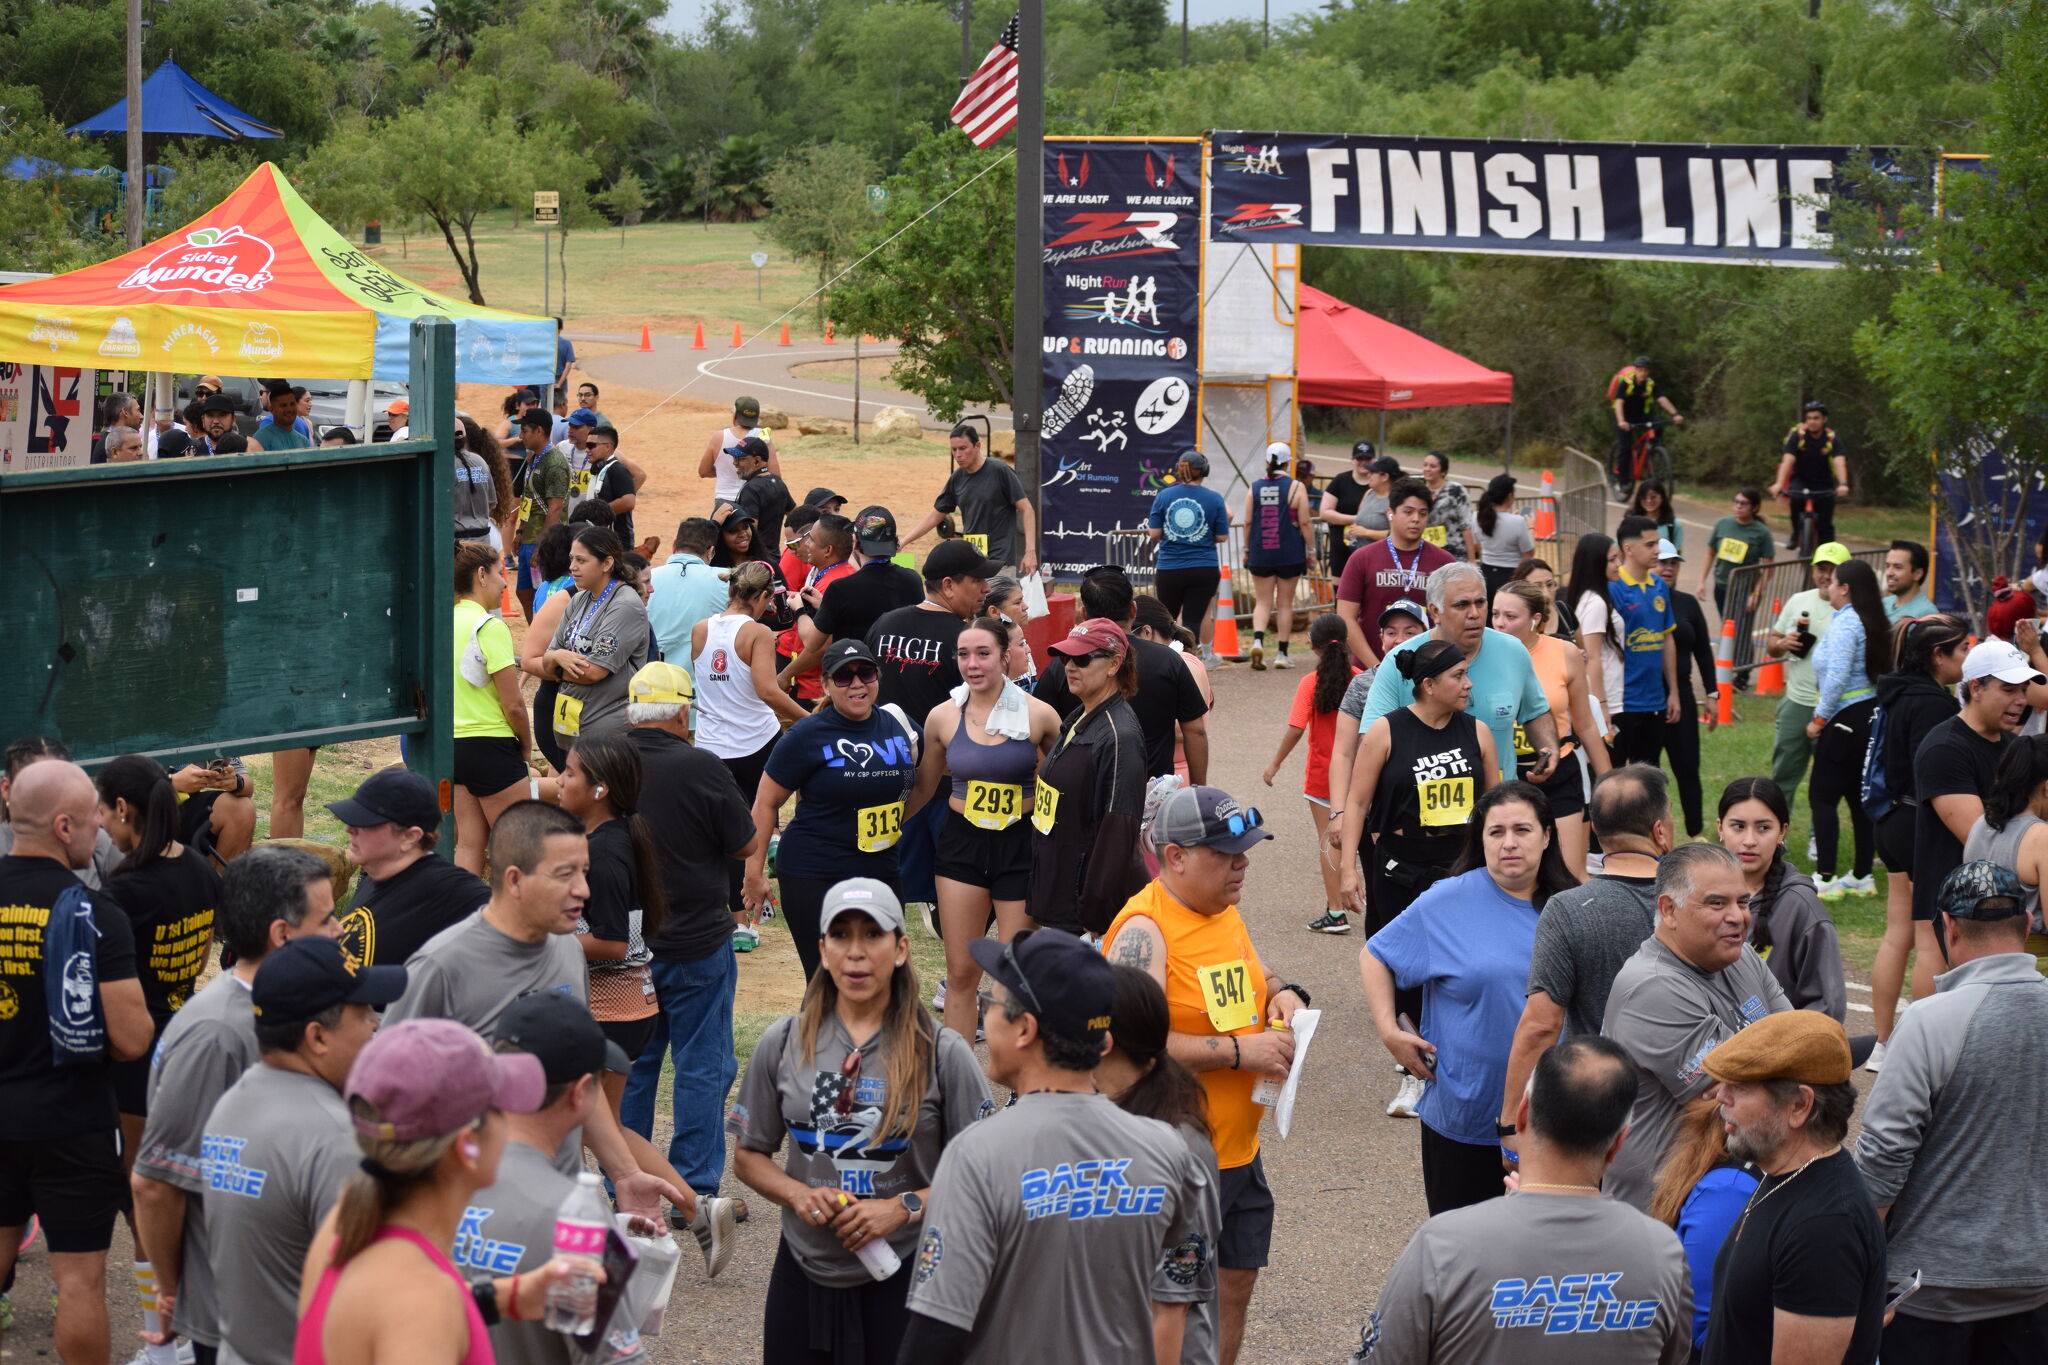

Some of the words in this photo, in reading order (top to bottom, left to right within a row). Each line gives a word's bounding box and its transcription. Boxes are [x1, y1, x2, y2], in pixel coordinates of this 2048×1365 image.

[1055, 195, 1076, 204] ARE
[1078, 195, 1109, 204] USATF
[1126, 196, 1142, 205] WE
[1143, 196, 1162, 205] ARE
[1164, 196, 1194, 206] USATF
[1307, 148, 1605, 240] FINISH
[1635, 156, 1834, 250] LINE
[1043, 245, 1088, 266] Zapata
[125, 265, 271, 289] Mundet
[160, 323, 221, 356] MINERAGUA
[240, 342, 284, 359] Mundet
[1043, 336, 1069, 354] UP
[1069, 337, 1081, 354] &
[1084, 337, 1167, 357] RUNNING
[24, 455, 77, 470] DISTRIBUTORS
[1077, 462, 1092, 471] Art
[1076, 473, 1086, 481] Of
[1087, 473, 1120, 484] Running
[1260, 486, 1281, 550] HARDER
[877, 634, 944, 662] HIGH
[709, 674, 730, 682] SANDY
[560, 699, 568, 721] 4
[1412, 747, 1463, 772] JUST
[1414, 766, 1447, 785] DO
[1449, 759, 1473, 775] IT.
[843, 770, 856, 778] MY
[857, 770, 870, 778] CBP
[872, 769, 900, 777] OFFICER
[972, 785, 1015, 815] 293
[1426, 782, 1466, 810] 504
[866, 807, 901, 838] 313
[0, 928, 14, 941] ou
[15, 925, 44, 943] first.
[155, 925, 167, 941] U
[182, 909, 215, 935] Training
[0, 944, 14, 958] ou
[14, 943, 43, 960] first.
[152, 943, 172, 955] You
[3, 959, 35, 976] first.
[157, 970, 179, 982] You
[1210, 966, 1245, 1008] 547
[201, 1132, 249, 1164] BACK
[209, 1163, 268, 1199] BLUE
[840, 1169, 876, 1196] 5K
[1022, 1158, 1133, 1203] BACK
[1024, 1194, 1069, 1221] THE
[1068, 1185, 1167, 1221] BLUE
[452, 1236, 527, 1275] LUE
[1489, 1271, 1624, 1310] BACK
[1492, 1305, 1548, 1329] THE
[1544, 1299, 1662, 1335] BLUE
